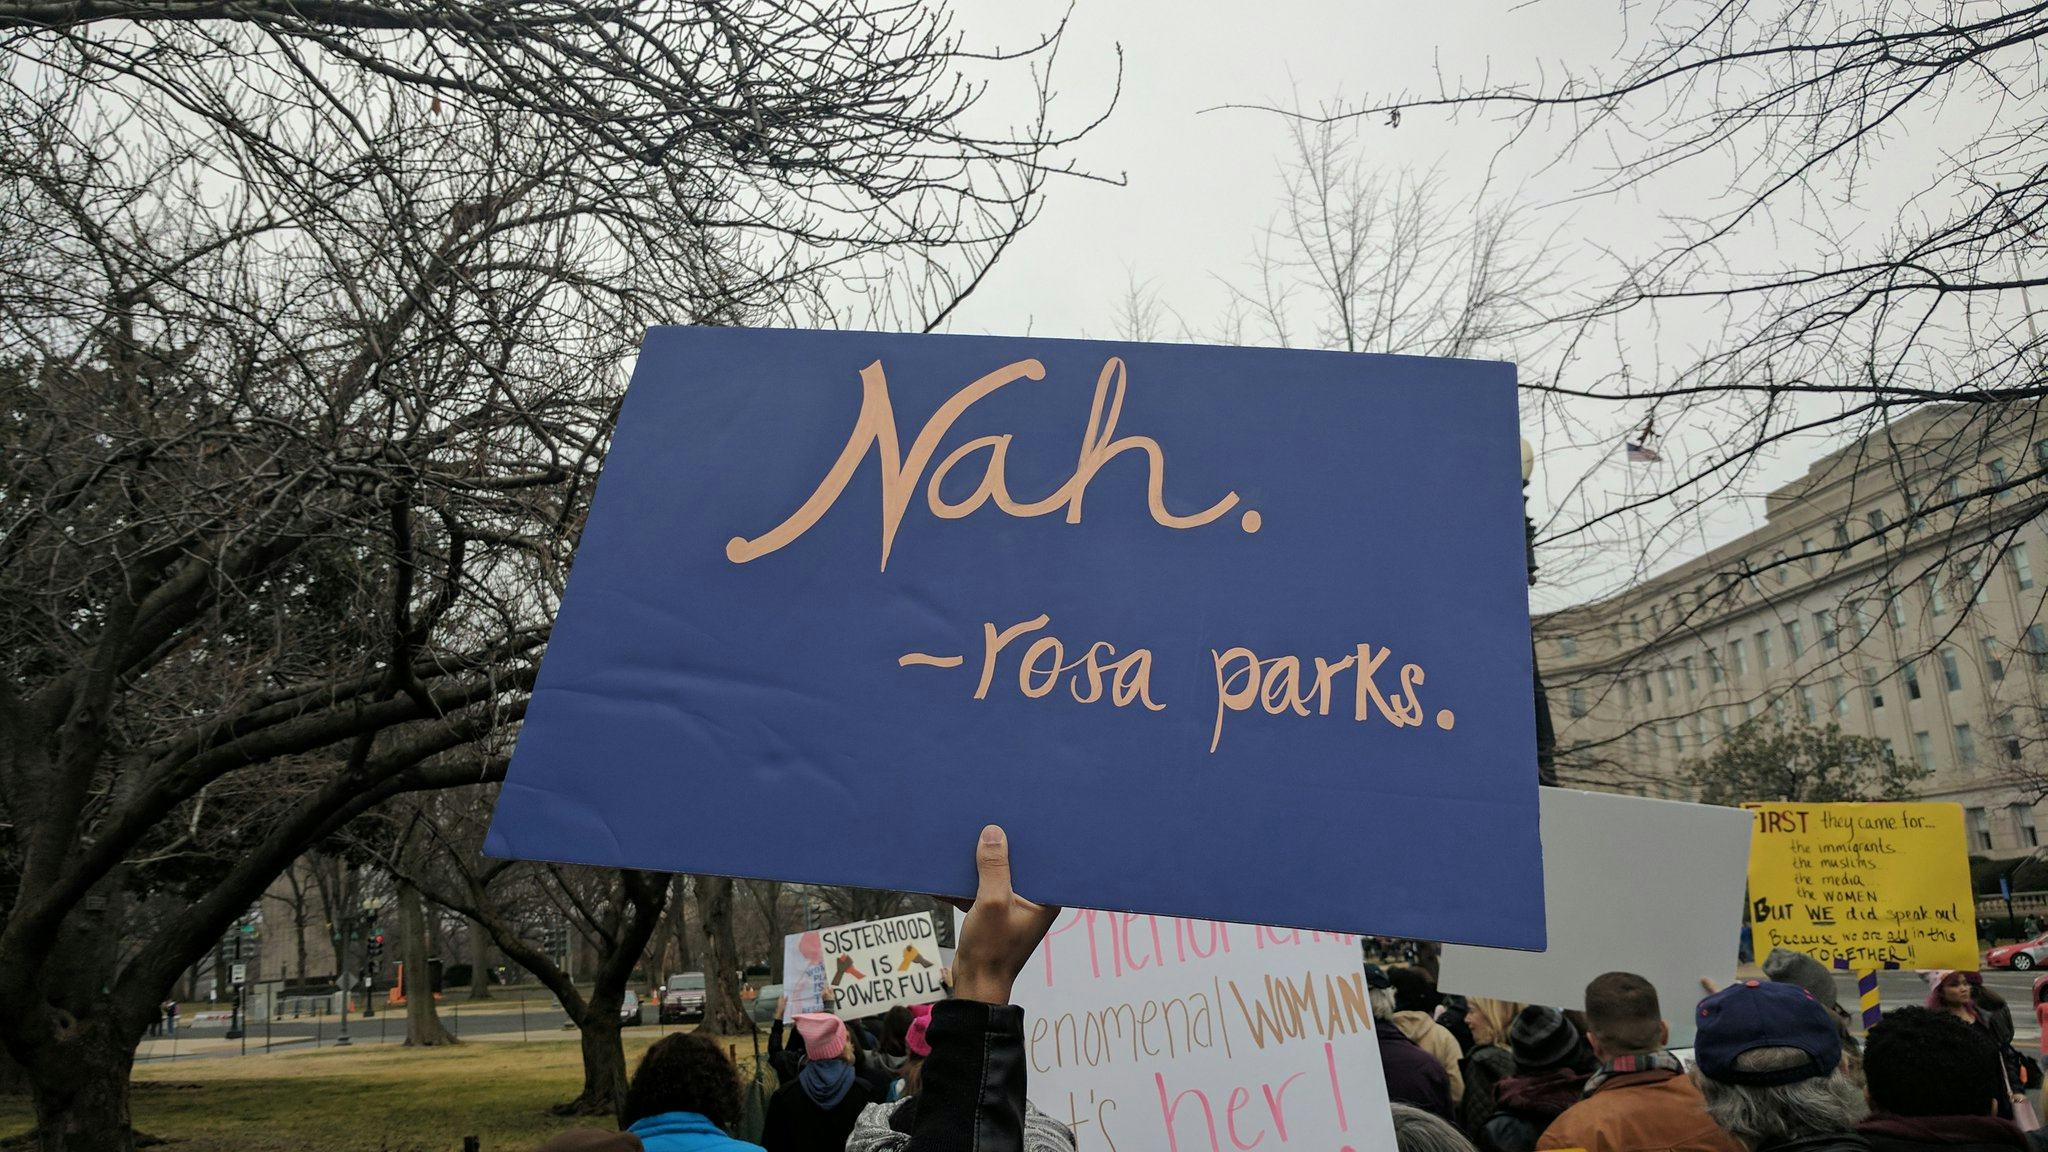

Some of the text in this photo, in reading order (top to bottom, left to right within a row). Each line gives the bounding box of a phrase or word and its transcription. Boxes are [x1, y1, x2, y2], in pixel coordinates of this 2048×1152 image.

[726, 357, 1262, 573] Nah.
[1210, 643, 1454, 753] parks.
[1820, 810, 1855, 843] they
[1858, 816, 1897, 830] came
[1791, 839, 1811, 853] the
[1793, 857, 1812, 868] the
[1795, 872, 1812, 885] the
[1797, 885, 1878, 903] the WOMEN
[1805, 904, 1836, 920] WE
[1846, 906, 1878, 920] did
[1886, 905, 1928, 927] speak
[822, 917, 932, 954] SISTERHOOD
[1843, 933, 1858, 941] we
[1862, 931, 1884, 941] are
[1887, 929, 1909, 943] all
[1912, 927, 1925, 939] in
[1927, 927, 1957, 942] this
[871, 955, 893, 977] IS
[833, 972, 941, 1010] POWERFUL
[1031, 970, 1372, 1074] enomenal WOMAN
[1066, 1088, 1118, 1152] t's
